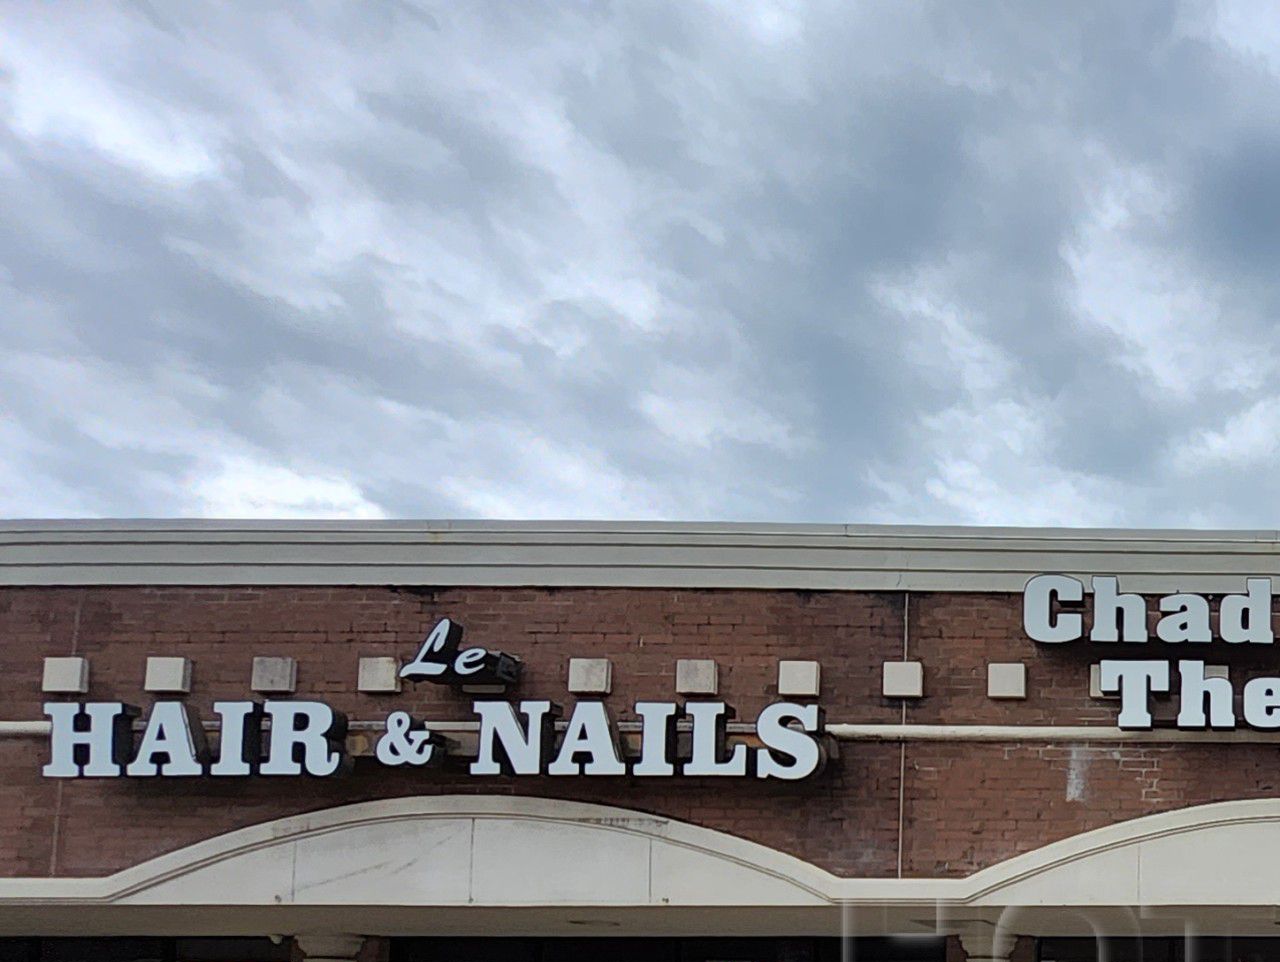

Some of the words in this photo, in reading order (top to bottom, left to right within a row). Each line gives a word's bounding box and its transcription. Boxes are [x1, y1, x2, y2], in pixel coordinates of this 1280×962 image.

[400, 618, 488, 677] Le
[42, 701, 342, 778] HAIR
[376, 711, 435, 767] &
[469, 701, 822, 781] NAILS
